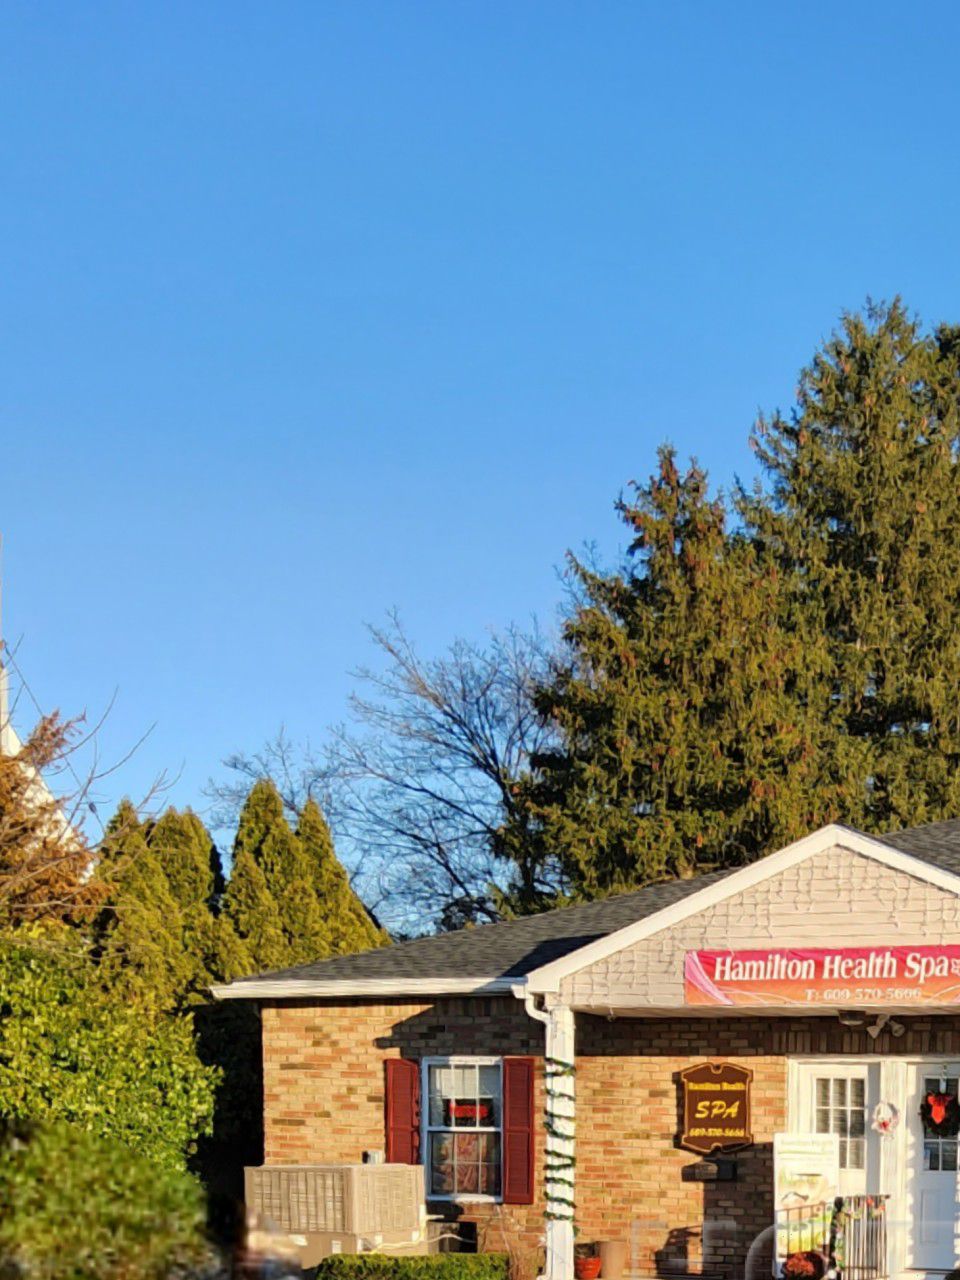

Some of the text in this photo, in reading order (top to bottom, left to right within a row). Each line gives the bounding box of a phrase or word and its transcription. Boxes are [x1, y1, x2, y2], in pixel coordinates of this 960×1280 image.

[714, 951, 949, 984] Hamilton Health Spa
[695, 1100, 740, 1119] SPA
